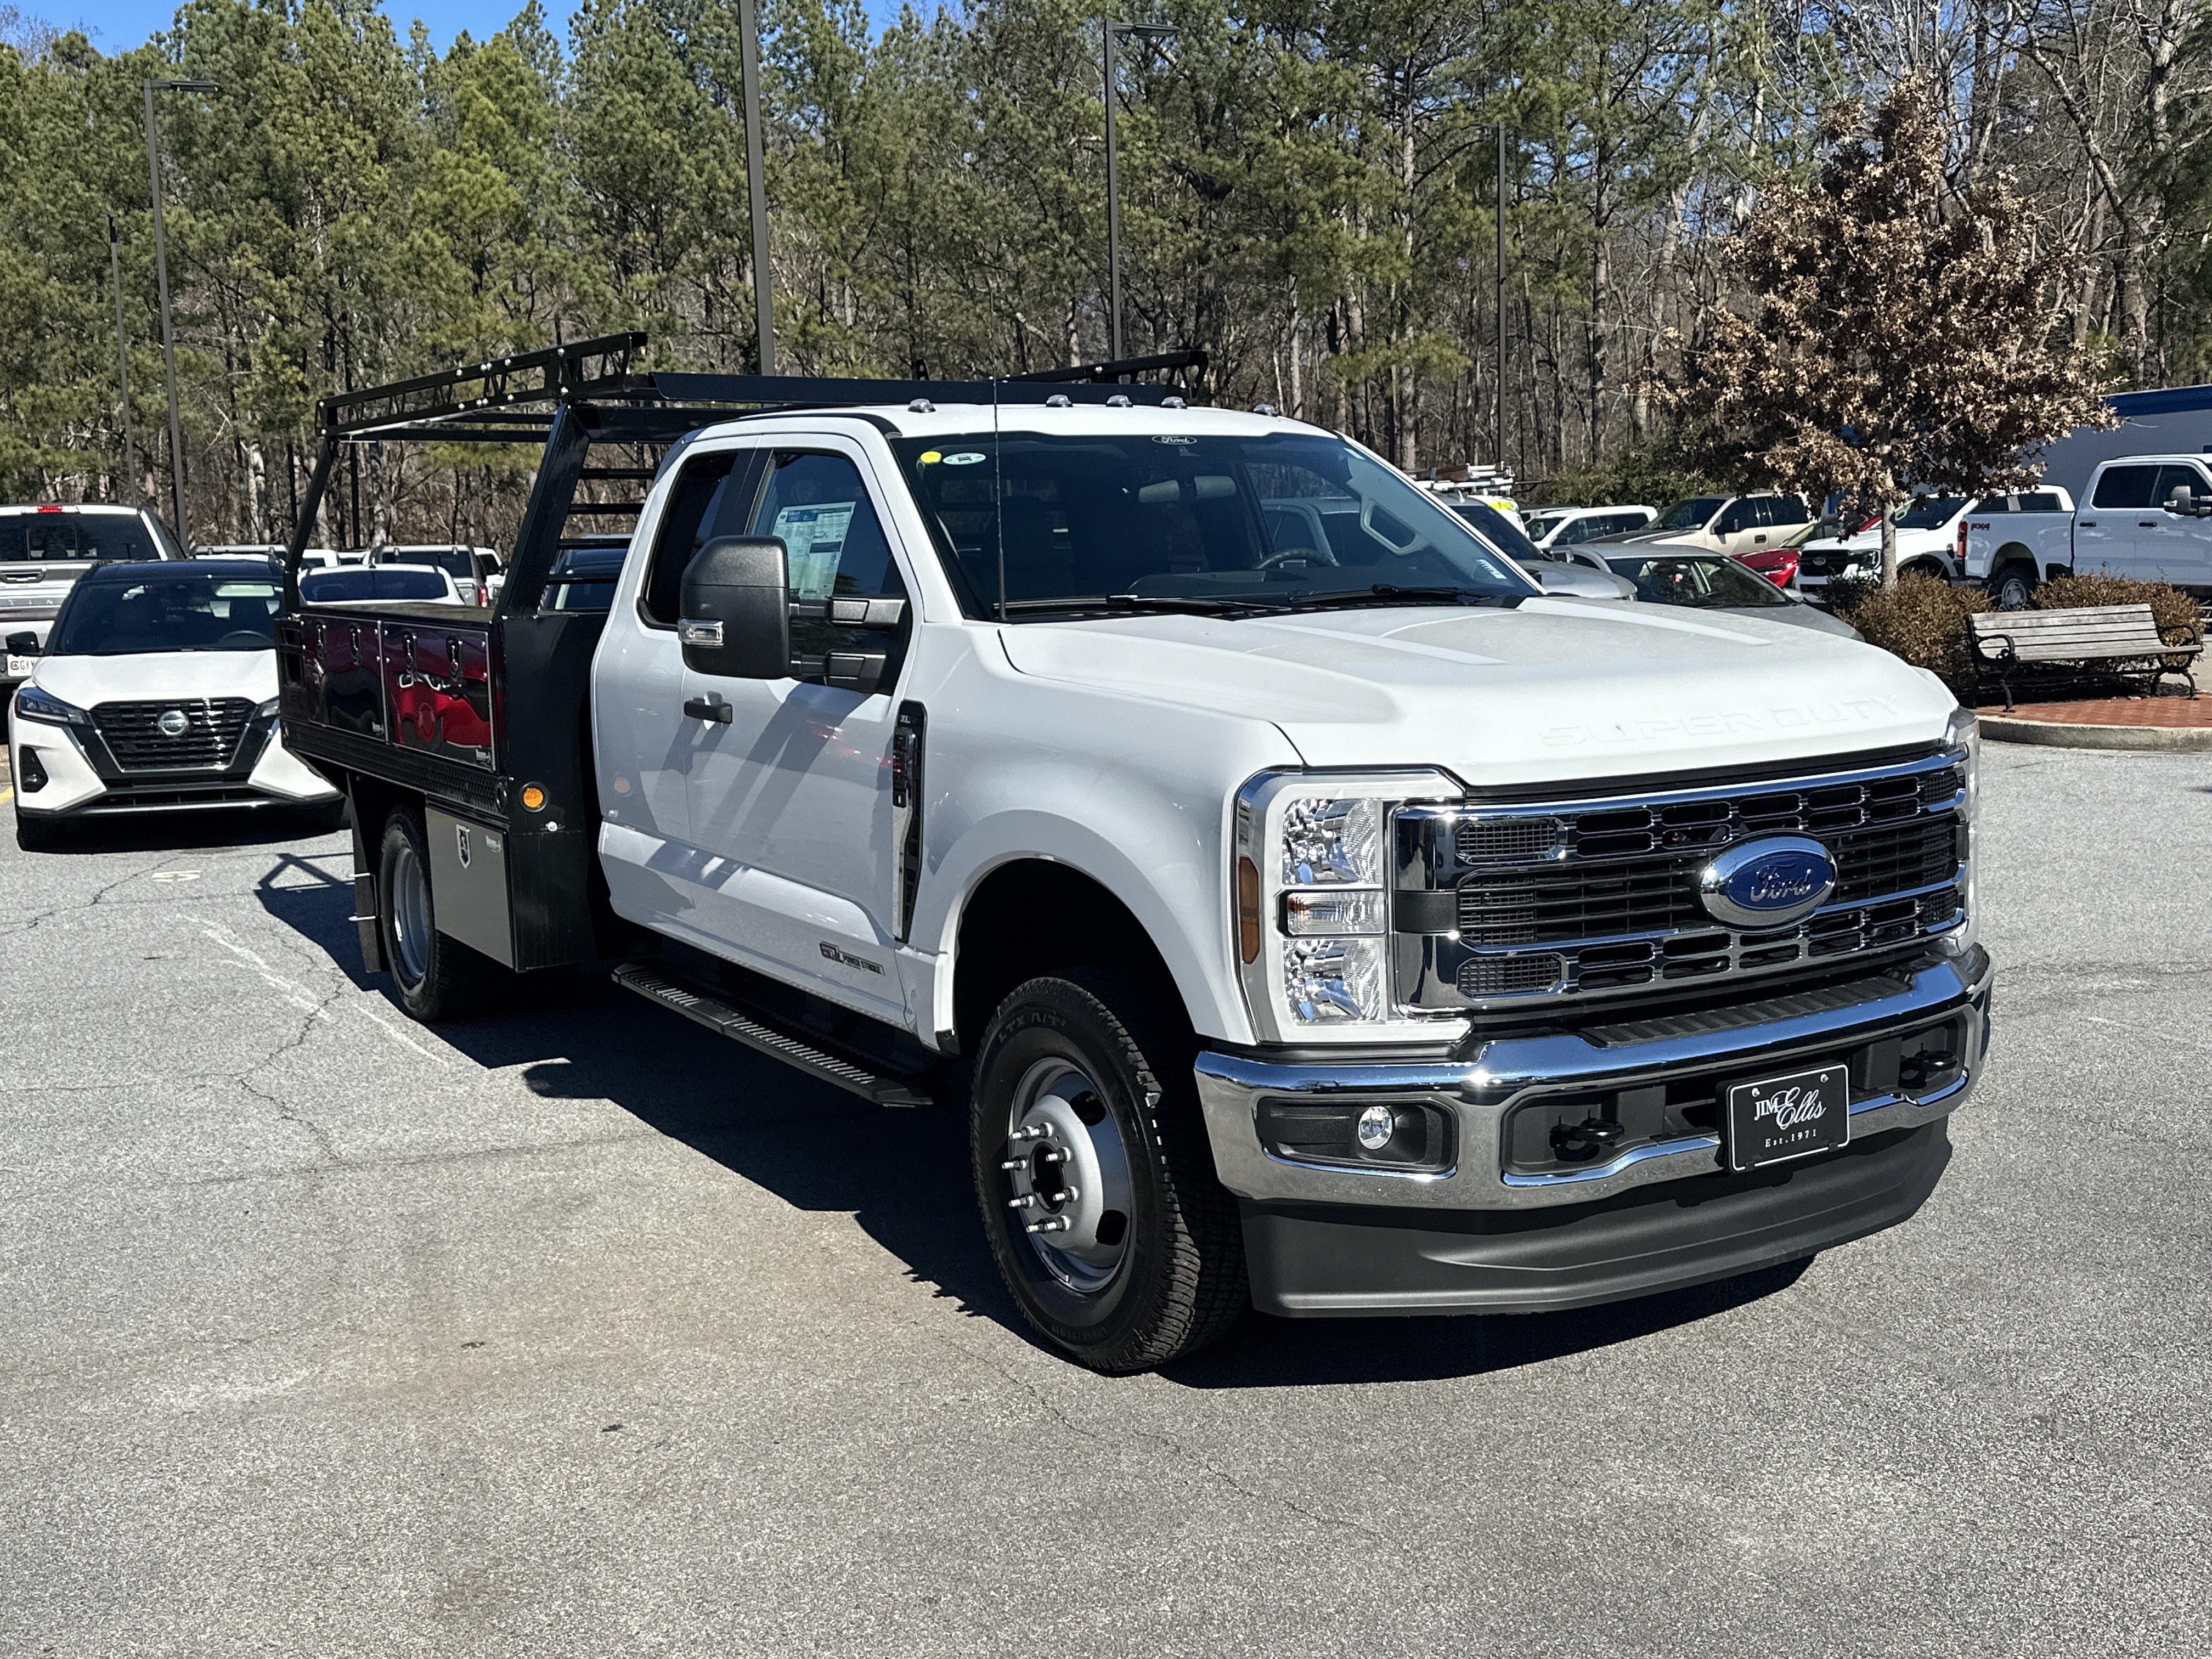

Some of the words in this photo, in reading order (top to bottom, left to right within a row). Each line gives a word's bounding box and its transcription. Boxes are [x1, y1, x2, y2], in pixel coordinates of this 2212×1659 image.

[900, 714, 911, 724] XL
[1750, 862, 1812, 902] Ford
[998, 1015, 1025, 1042] LTX
[1754, 1097, 1779, 1121] JIM
[1771, 1087, 1827, 1130] Ellis
